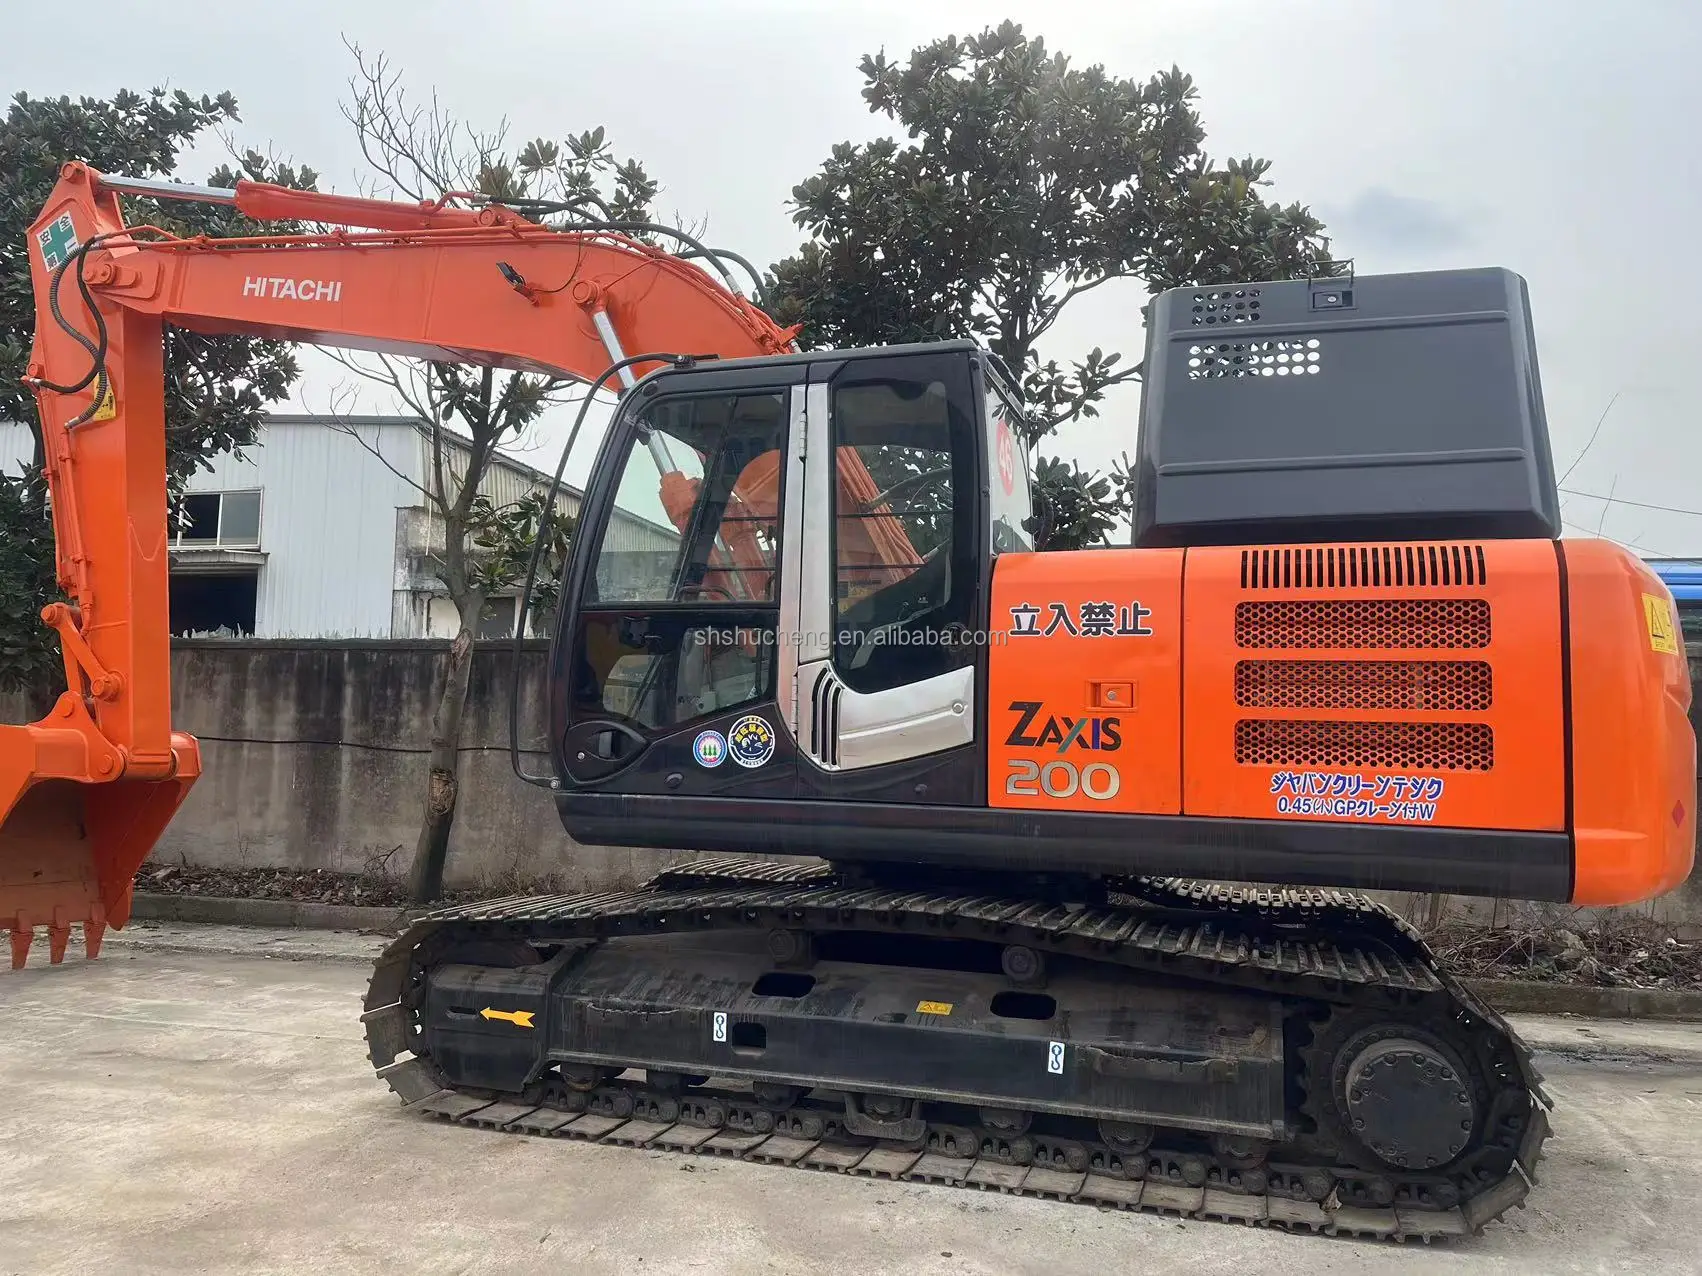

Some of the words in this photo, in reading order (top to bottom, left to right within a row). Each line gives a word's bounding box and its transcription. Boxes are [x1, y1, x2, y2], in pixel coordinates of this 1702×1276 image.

[242, 276, 342, 302] HITACHI
[1009, 601, 1153, 637] 立入禁止
[1005, 759, 1121, 801] 200
